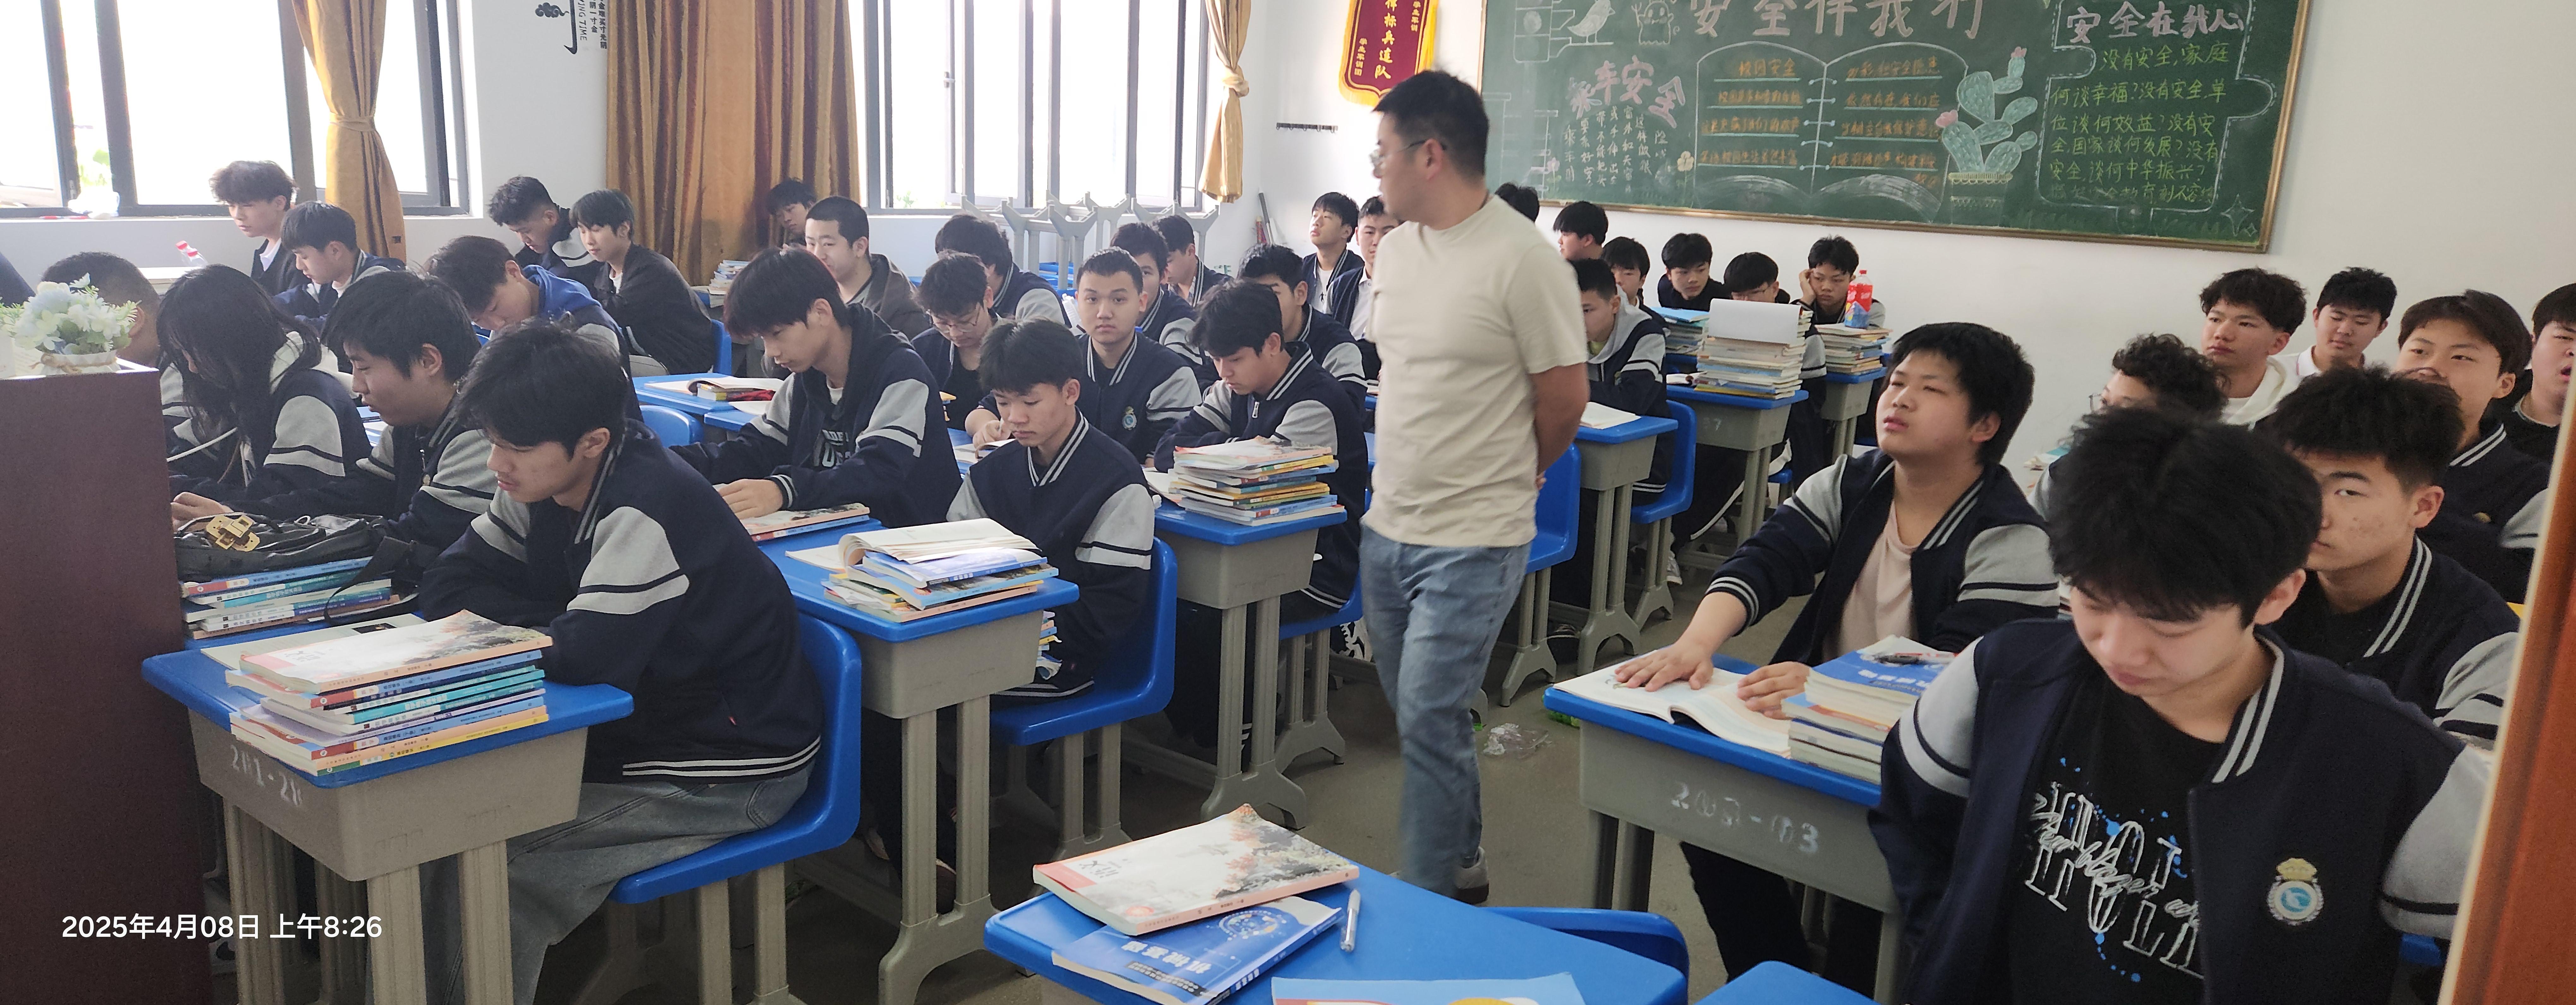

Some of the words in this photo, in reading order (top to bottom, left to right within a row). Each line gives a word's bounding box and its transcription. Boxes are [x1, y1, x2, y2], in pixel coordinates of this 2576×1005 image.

[579, 20, 587, 40] TIME
[2067, 1, 2244, 44] 安全在我心
